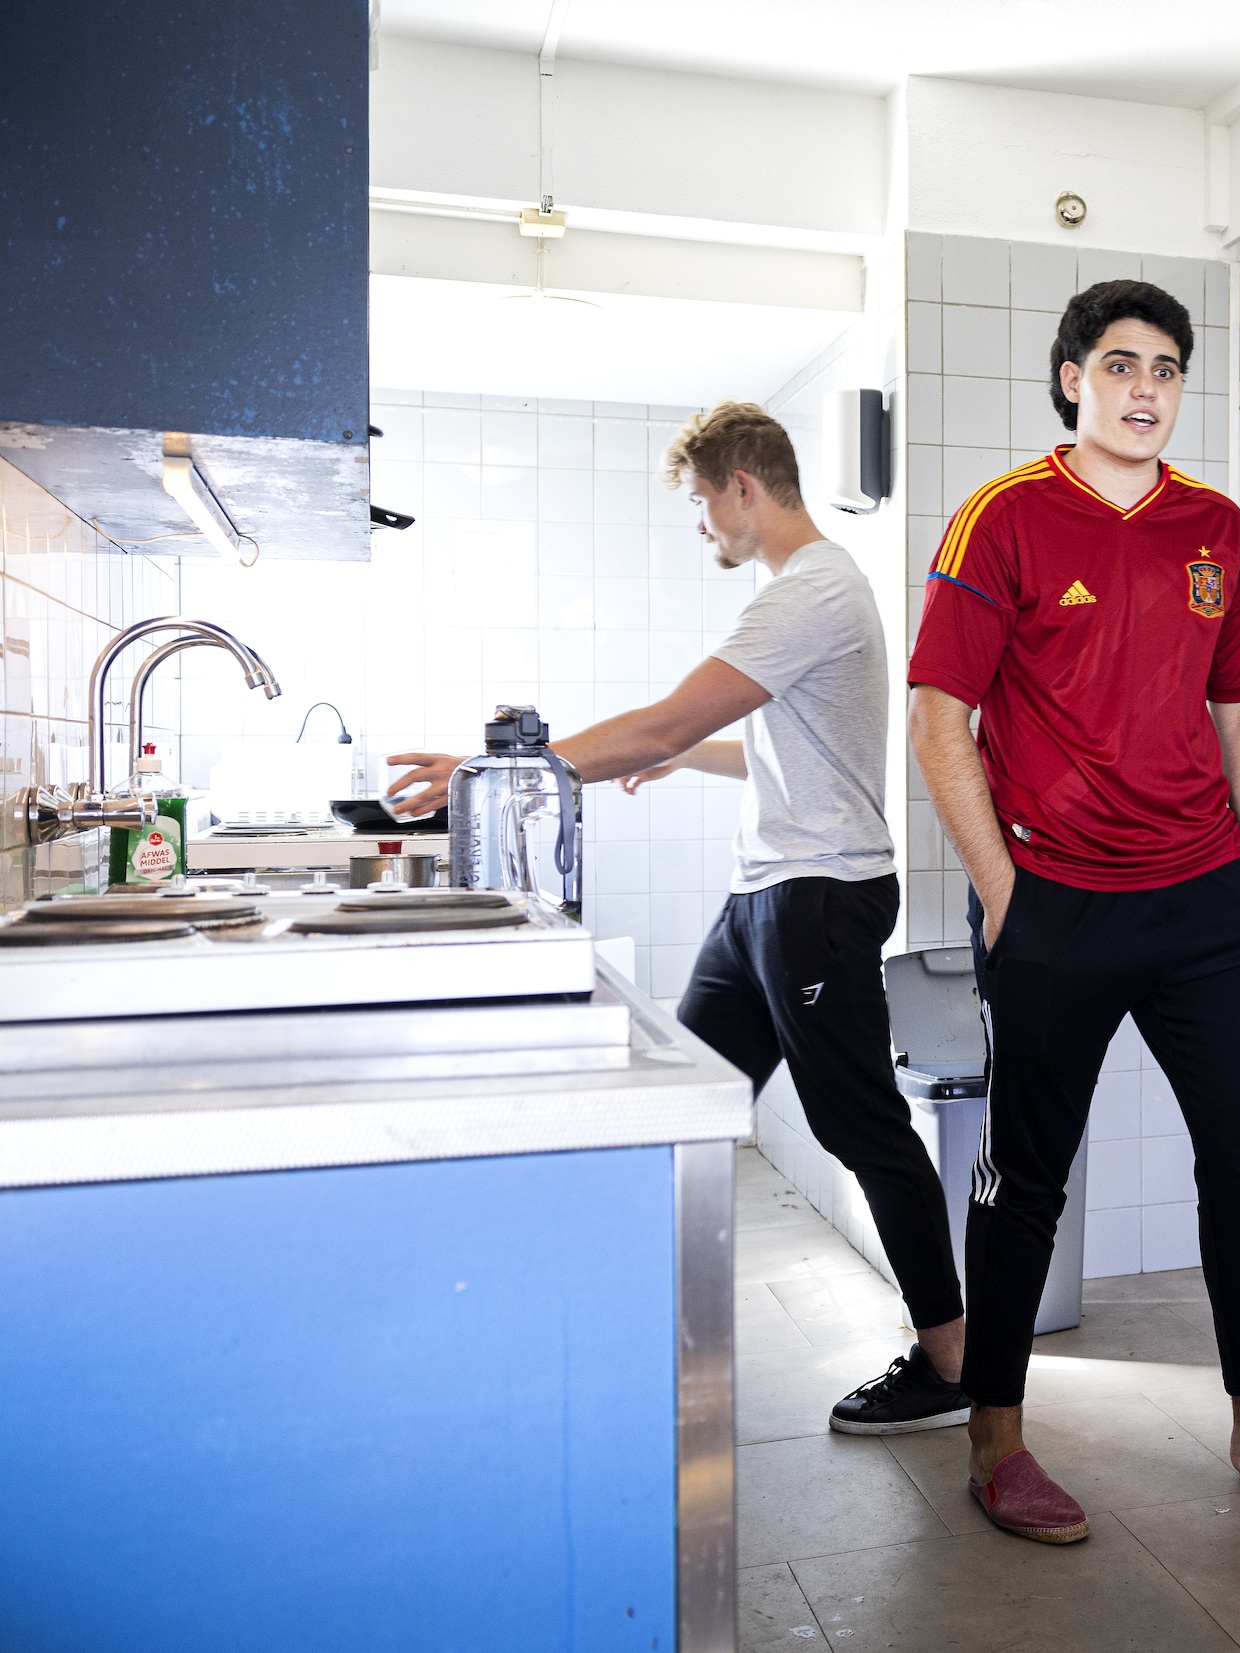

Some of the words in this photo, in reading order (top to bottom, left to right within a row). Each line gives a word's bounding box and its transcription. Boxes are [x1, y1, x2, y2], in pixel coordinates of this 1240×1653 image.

[1059, 595, 1097, 606] adidas
[141, 848, 170, 859] AFWAS
[140, 857, 171, 867] MIDDEL
